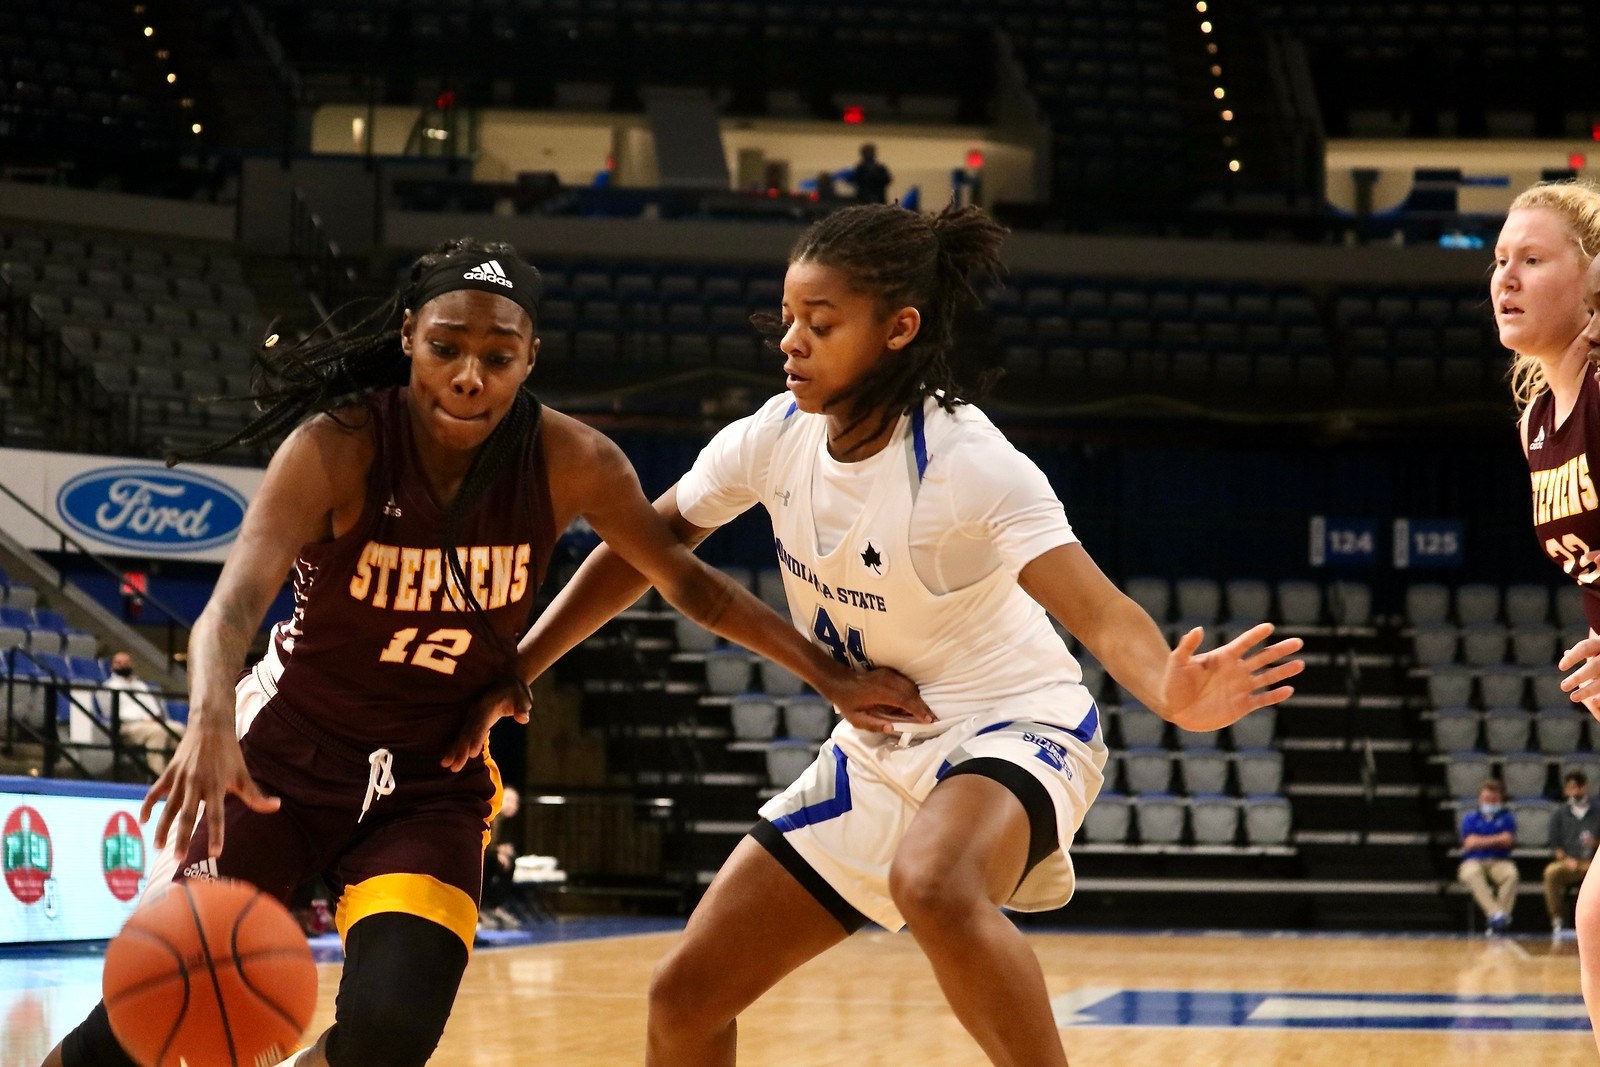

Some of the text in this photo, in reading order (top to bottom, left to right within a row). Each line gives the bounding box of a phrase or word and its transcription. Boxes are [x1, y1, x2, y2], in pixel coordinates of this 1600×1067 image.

[463, 271, 513, 289] adidas
[95, 478, 213, 538] Ford
[1329, 531, 1373, 554] 124
[1414, 532, 1457, 555] 125
[349, 540, 531, 612] STEPHENS
[836, 587, 887, 613] STATE
[379, 627, 473, 675] 12
